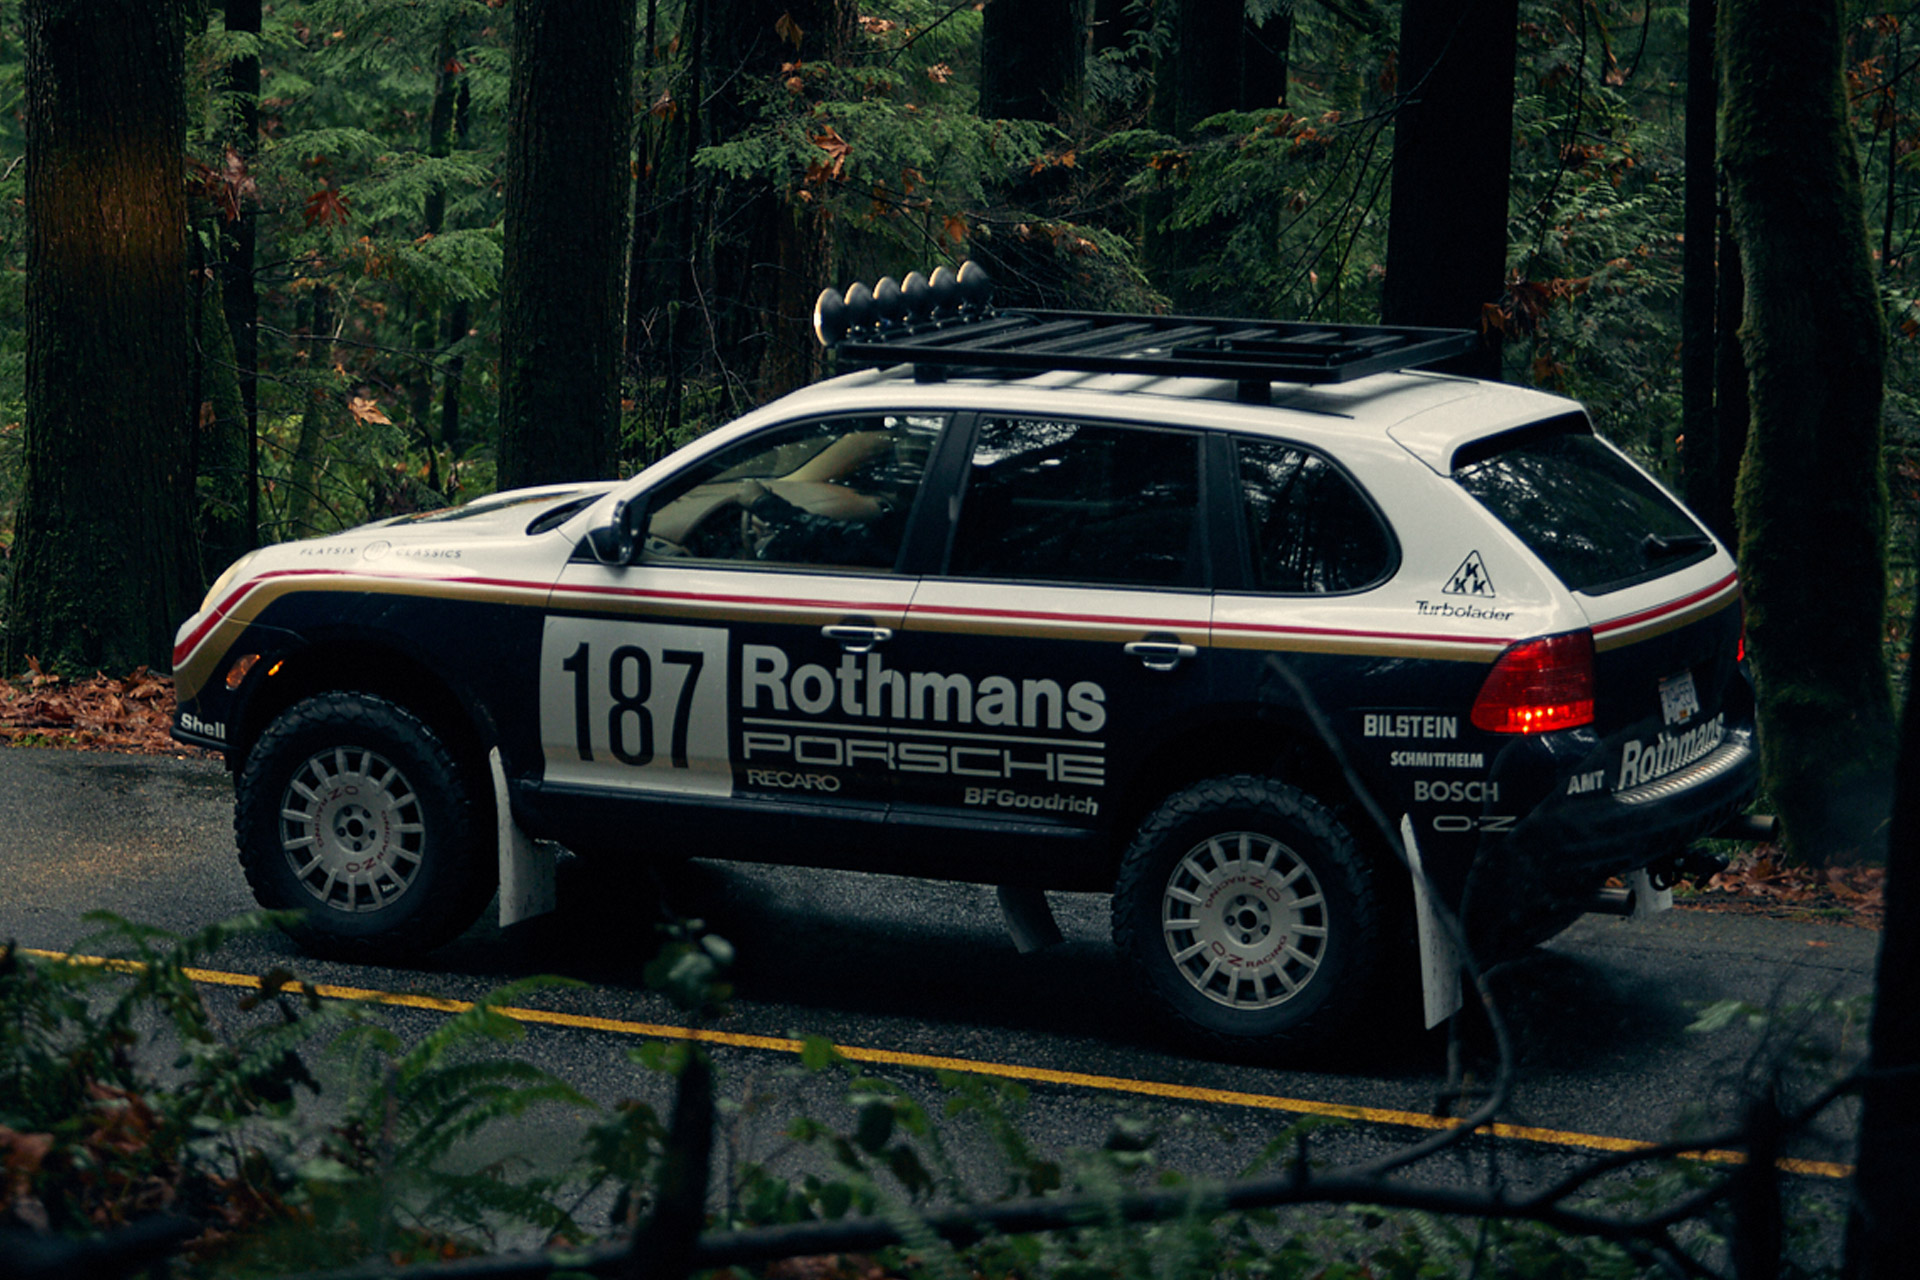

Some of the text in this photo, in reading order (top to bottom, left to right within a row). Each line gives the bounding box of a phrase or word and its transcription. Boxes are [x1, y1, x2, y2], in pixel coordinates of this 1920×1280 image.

[1416, 600, 1514, 621] Turbolader
[741, 643, 1106, 733] Rothmans
[562, 641, 704, 768] 187
[180, 712, 226, 739] Shell
[1364, 714, 1457, 739] BILSTEIN
[743, 731, 1105, 786] PORSCHE
[1390, 751, 1484, 768] SCHMITTHELM
[1618, 712, 1724, 791] Rothmans
[746, 769, 841, 792] RECARO
[1414, 780, 1499, 802] BOSCH
[1567, 770, 1605, 795] AMT
[963, 787, 1099, 816] BFGoodrich
